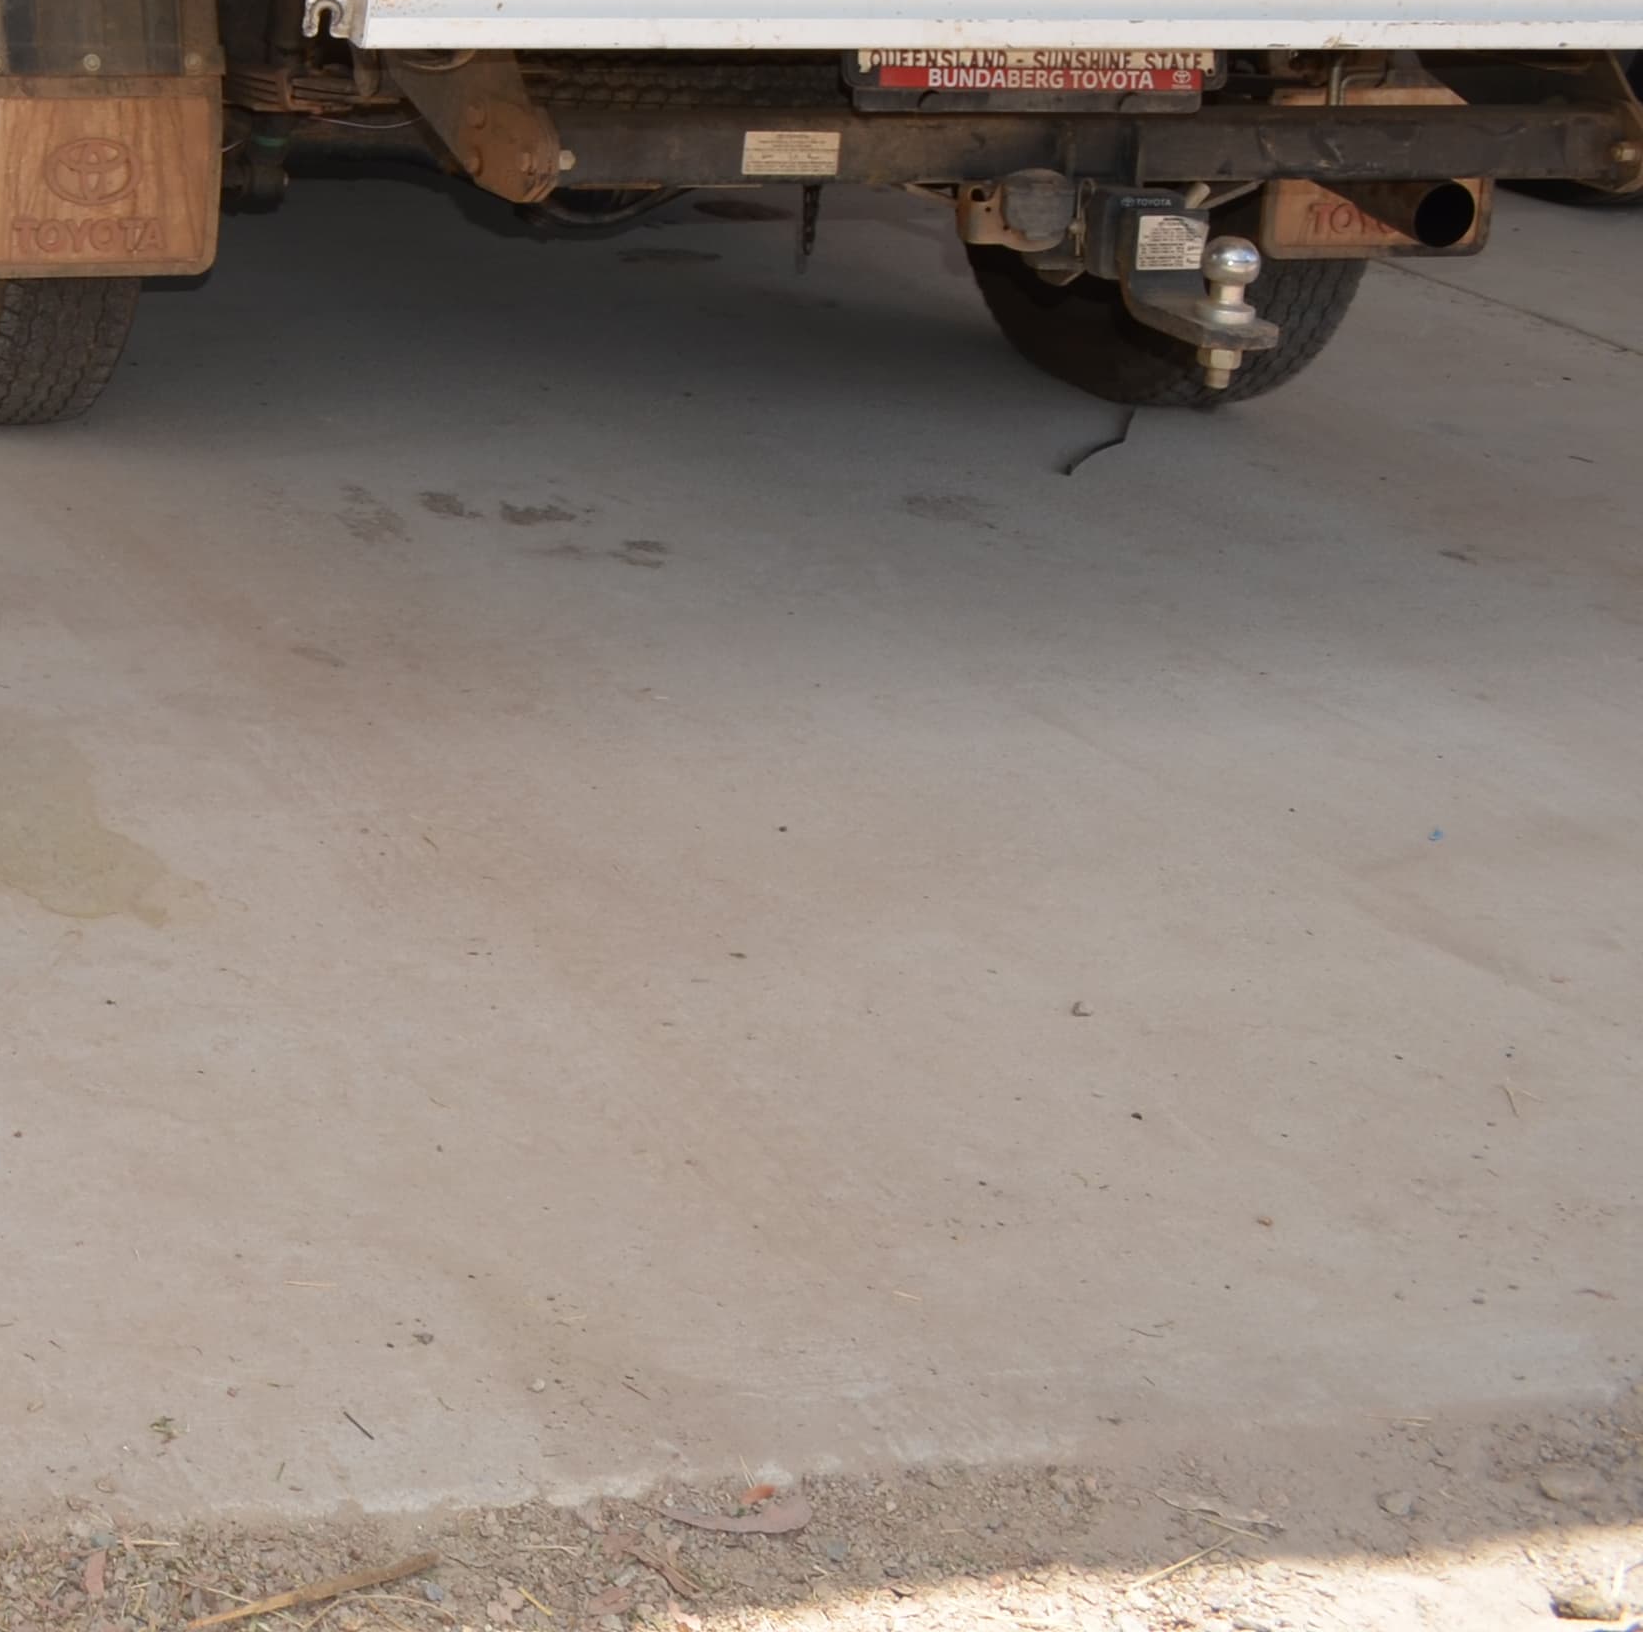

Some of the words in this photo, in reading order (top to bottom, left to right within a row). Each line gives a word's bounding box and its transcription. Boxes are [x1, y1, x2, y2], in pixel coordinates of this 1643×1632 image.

[870, 49, 1008, 68] QUEENSLAND
[1033, 50, 1132, 69] SUNSHINE
[1144, 52, 1203, 70] STATE
[927, 69, 1064, 89] BUNDABERG
[1070, 70, 1155, 89] TOYOTA
[1136, 197, 1172, 207] TOYOTA
[11, 216, 167, 254] TOYOTA
